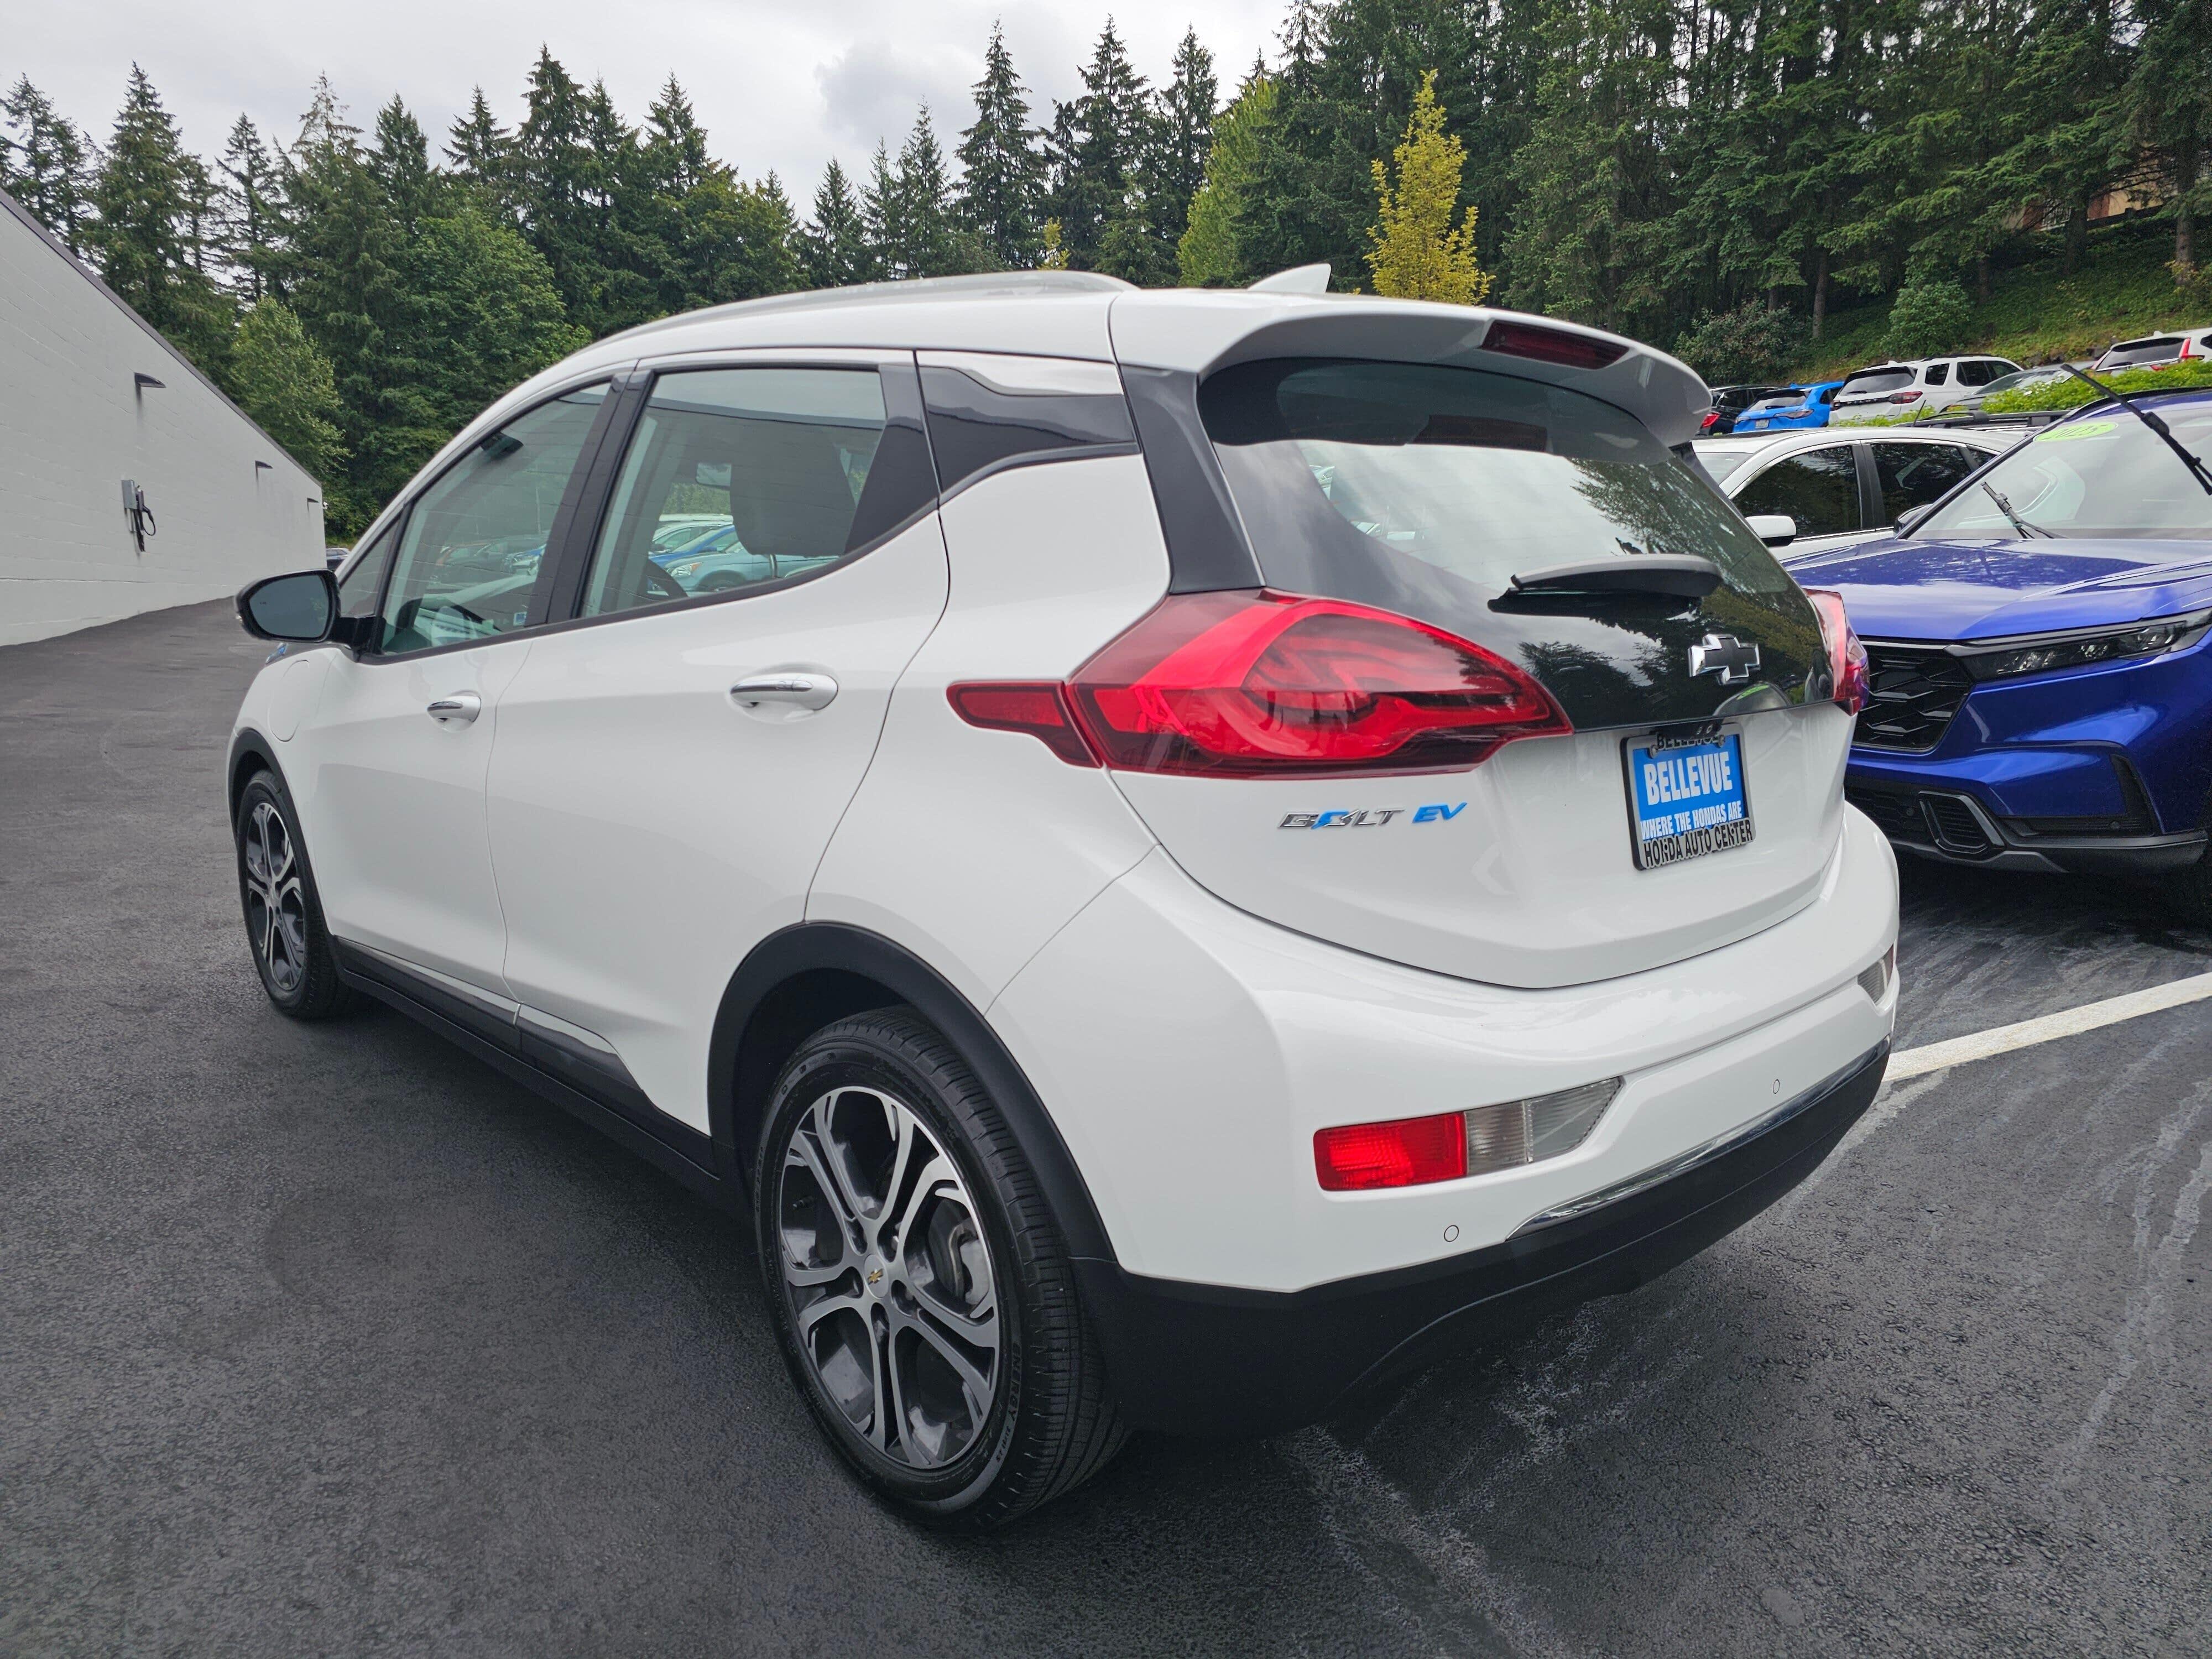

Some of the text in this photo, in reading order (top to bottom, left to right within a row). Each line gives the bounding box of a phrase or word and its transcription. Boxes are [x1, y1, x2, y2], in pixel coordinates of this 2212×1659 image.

[1644, 752, 1733, 806] BELLEVUE
[1277, 802, 1468, 830] BOLT EV
[1640, 800, 1743, 840] WHERE THE HONDAS ARE
[1643, 820, 1753, 867] HONDA AUTO CENTER
